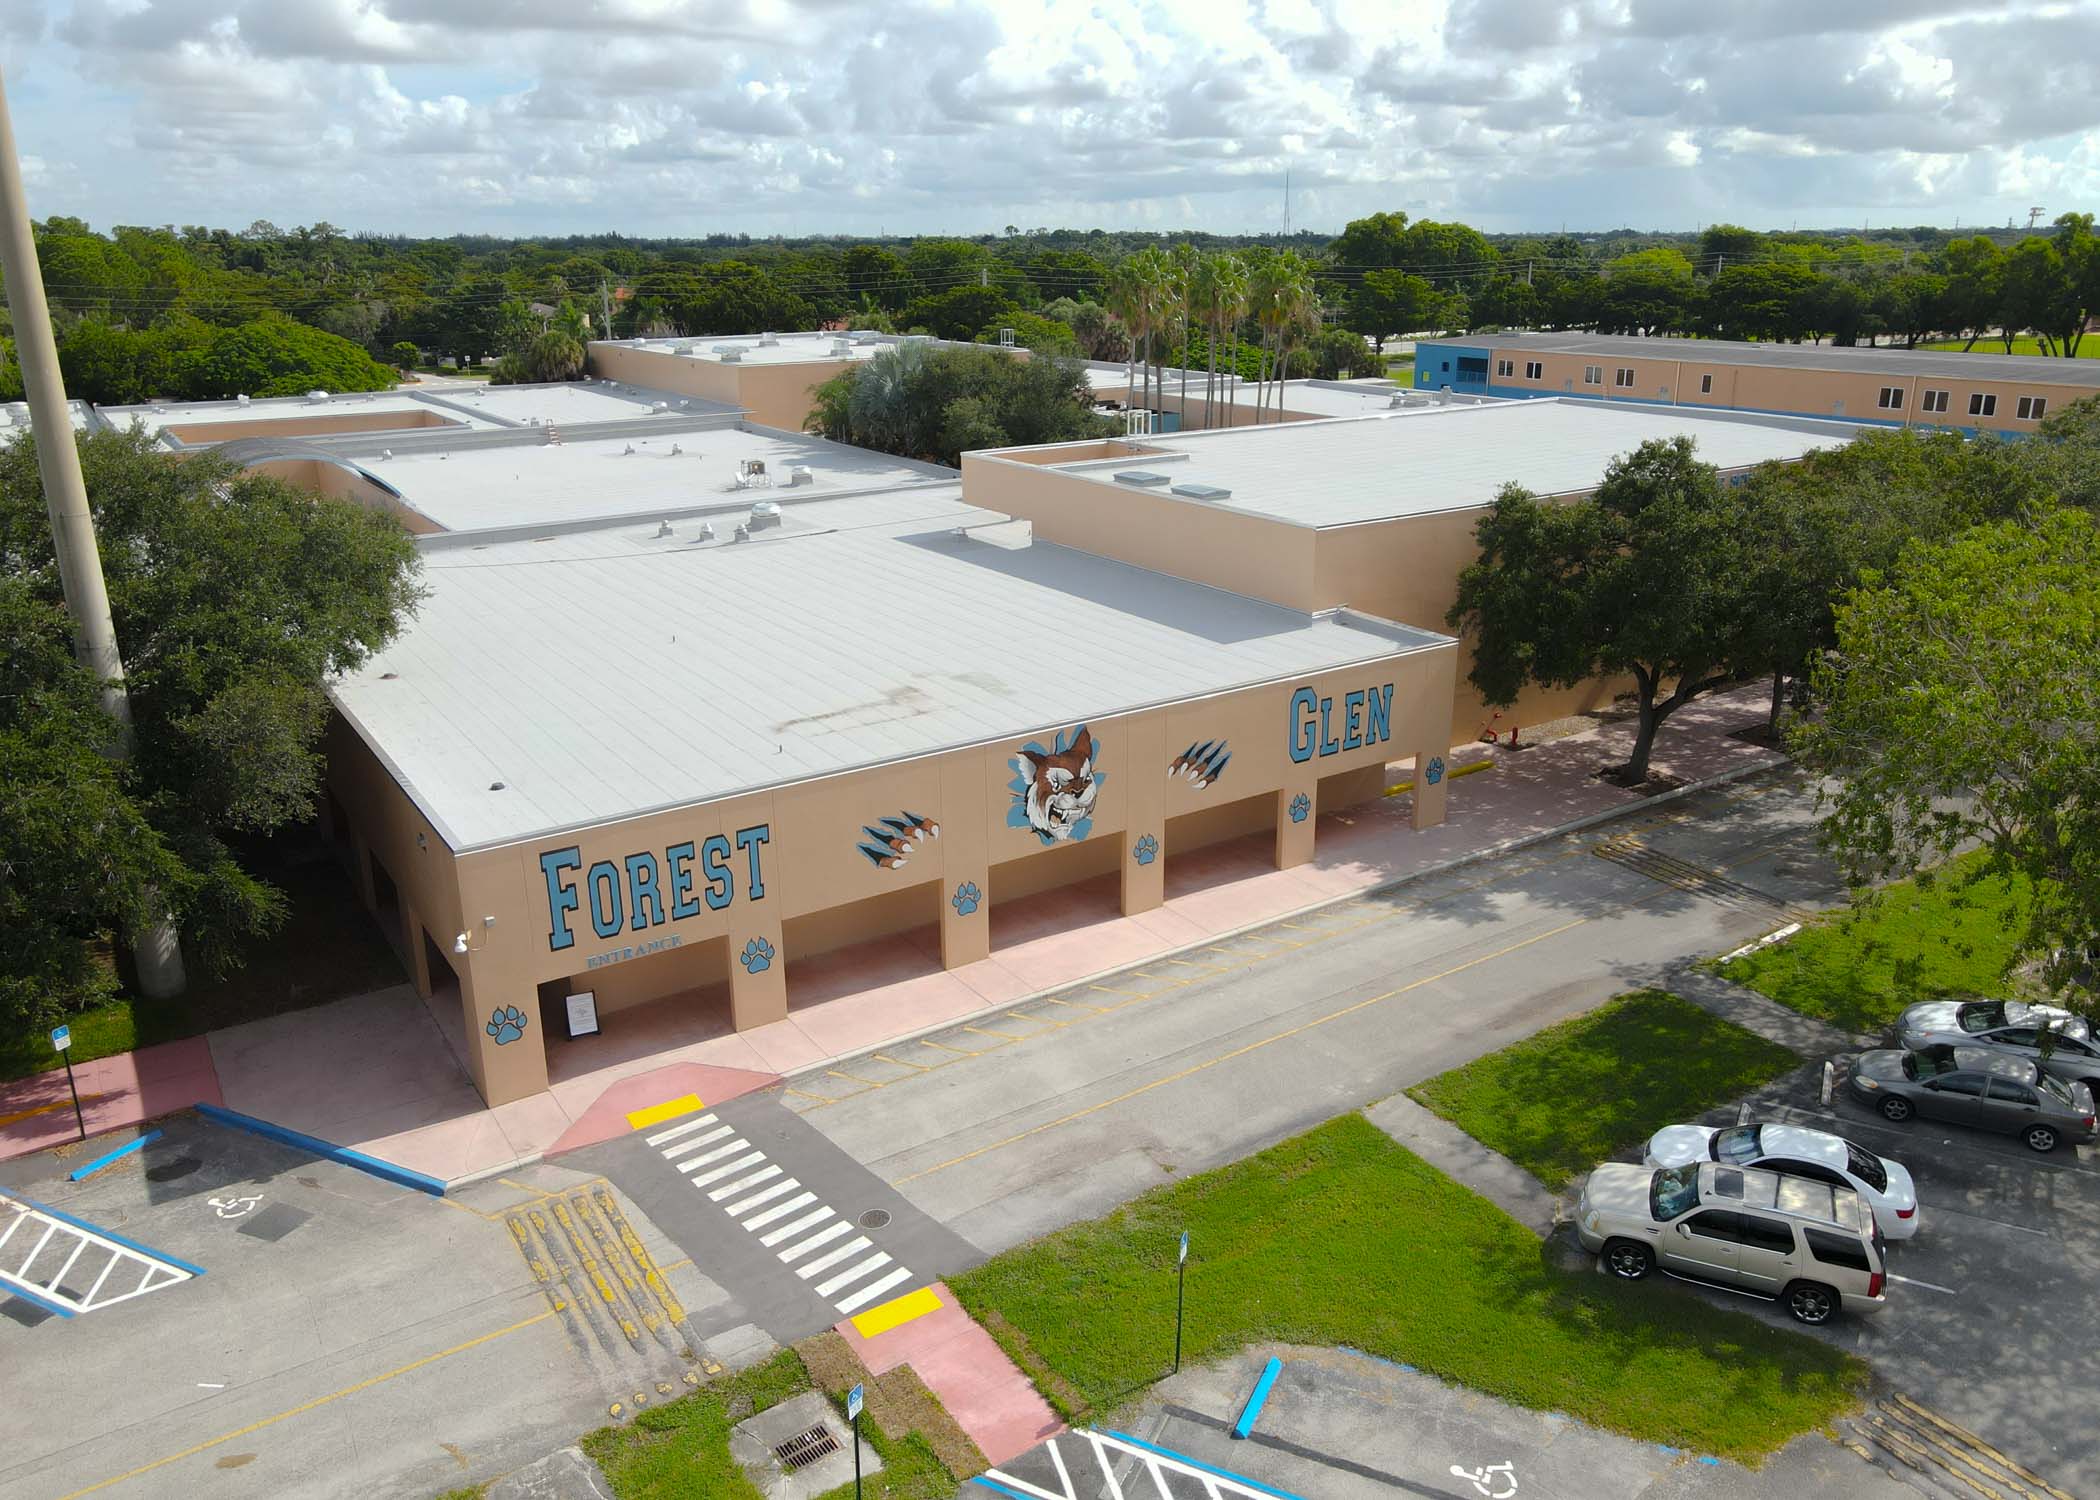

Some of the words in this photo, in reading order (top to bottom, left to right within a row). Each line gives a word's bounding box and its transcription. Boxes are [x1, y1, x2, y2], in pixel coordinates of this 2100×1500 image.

[540, 823, 770, 952] FOREST
[1289, 683, 1394, 764] GLEN
[586, 934, 682, 969] ENTRANCE
